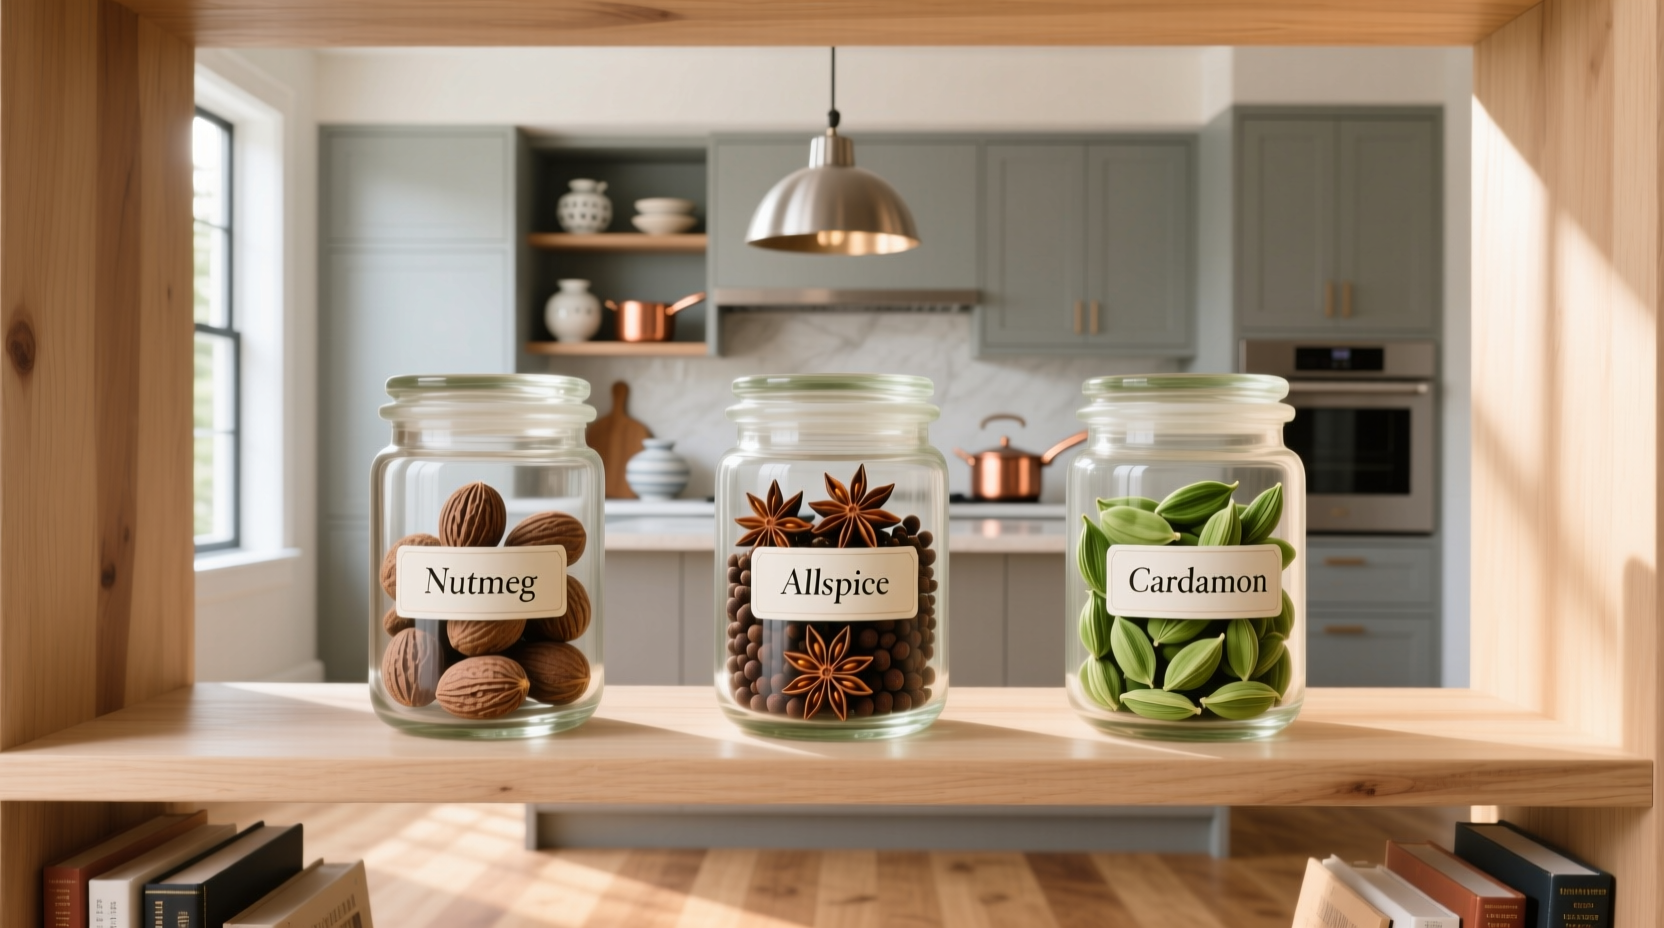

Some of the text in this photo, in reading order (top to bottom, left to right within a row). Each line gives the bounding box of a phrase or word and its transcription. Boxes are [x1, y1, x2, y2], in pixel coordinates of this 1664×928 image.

[425, 567, 538, 603] Nutmeg
[780, 567, 890, 605] Allspice
[1129, 566, 1268, 595] Cardamon
